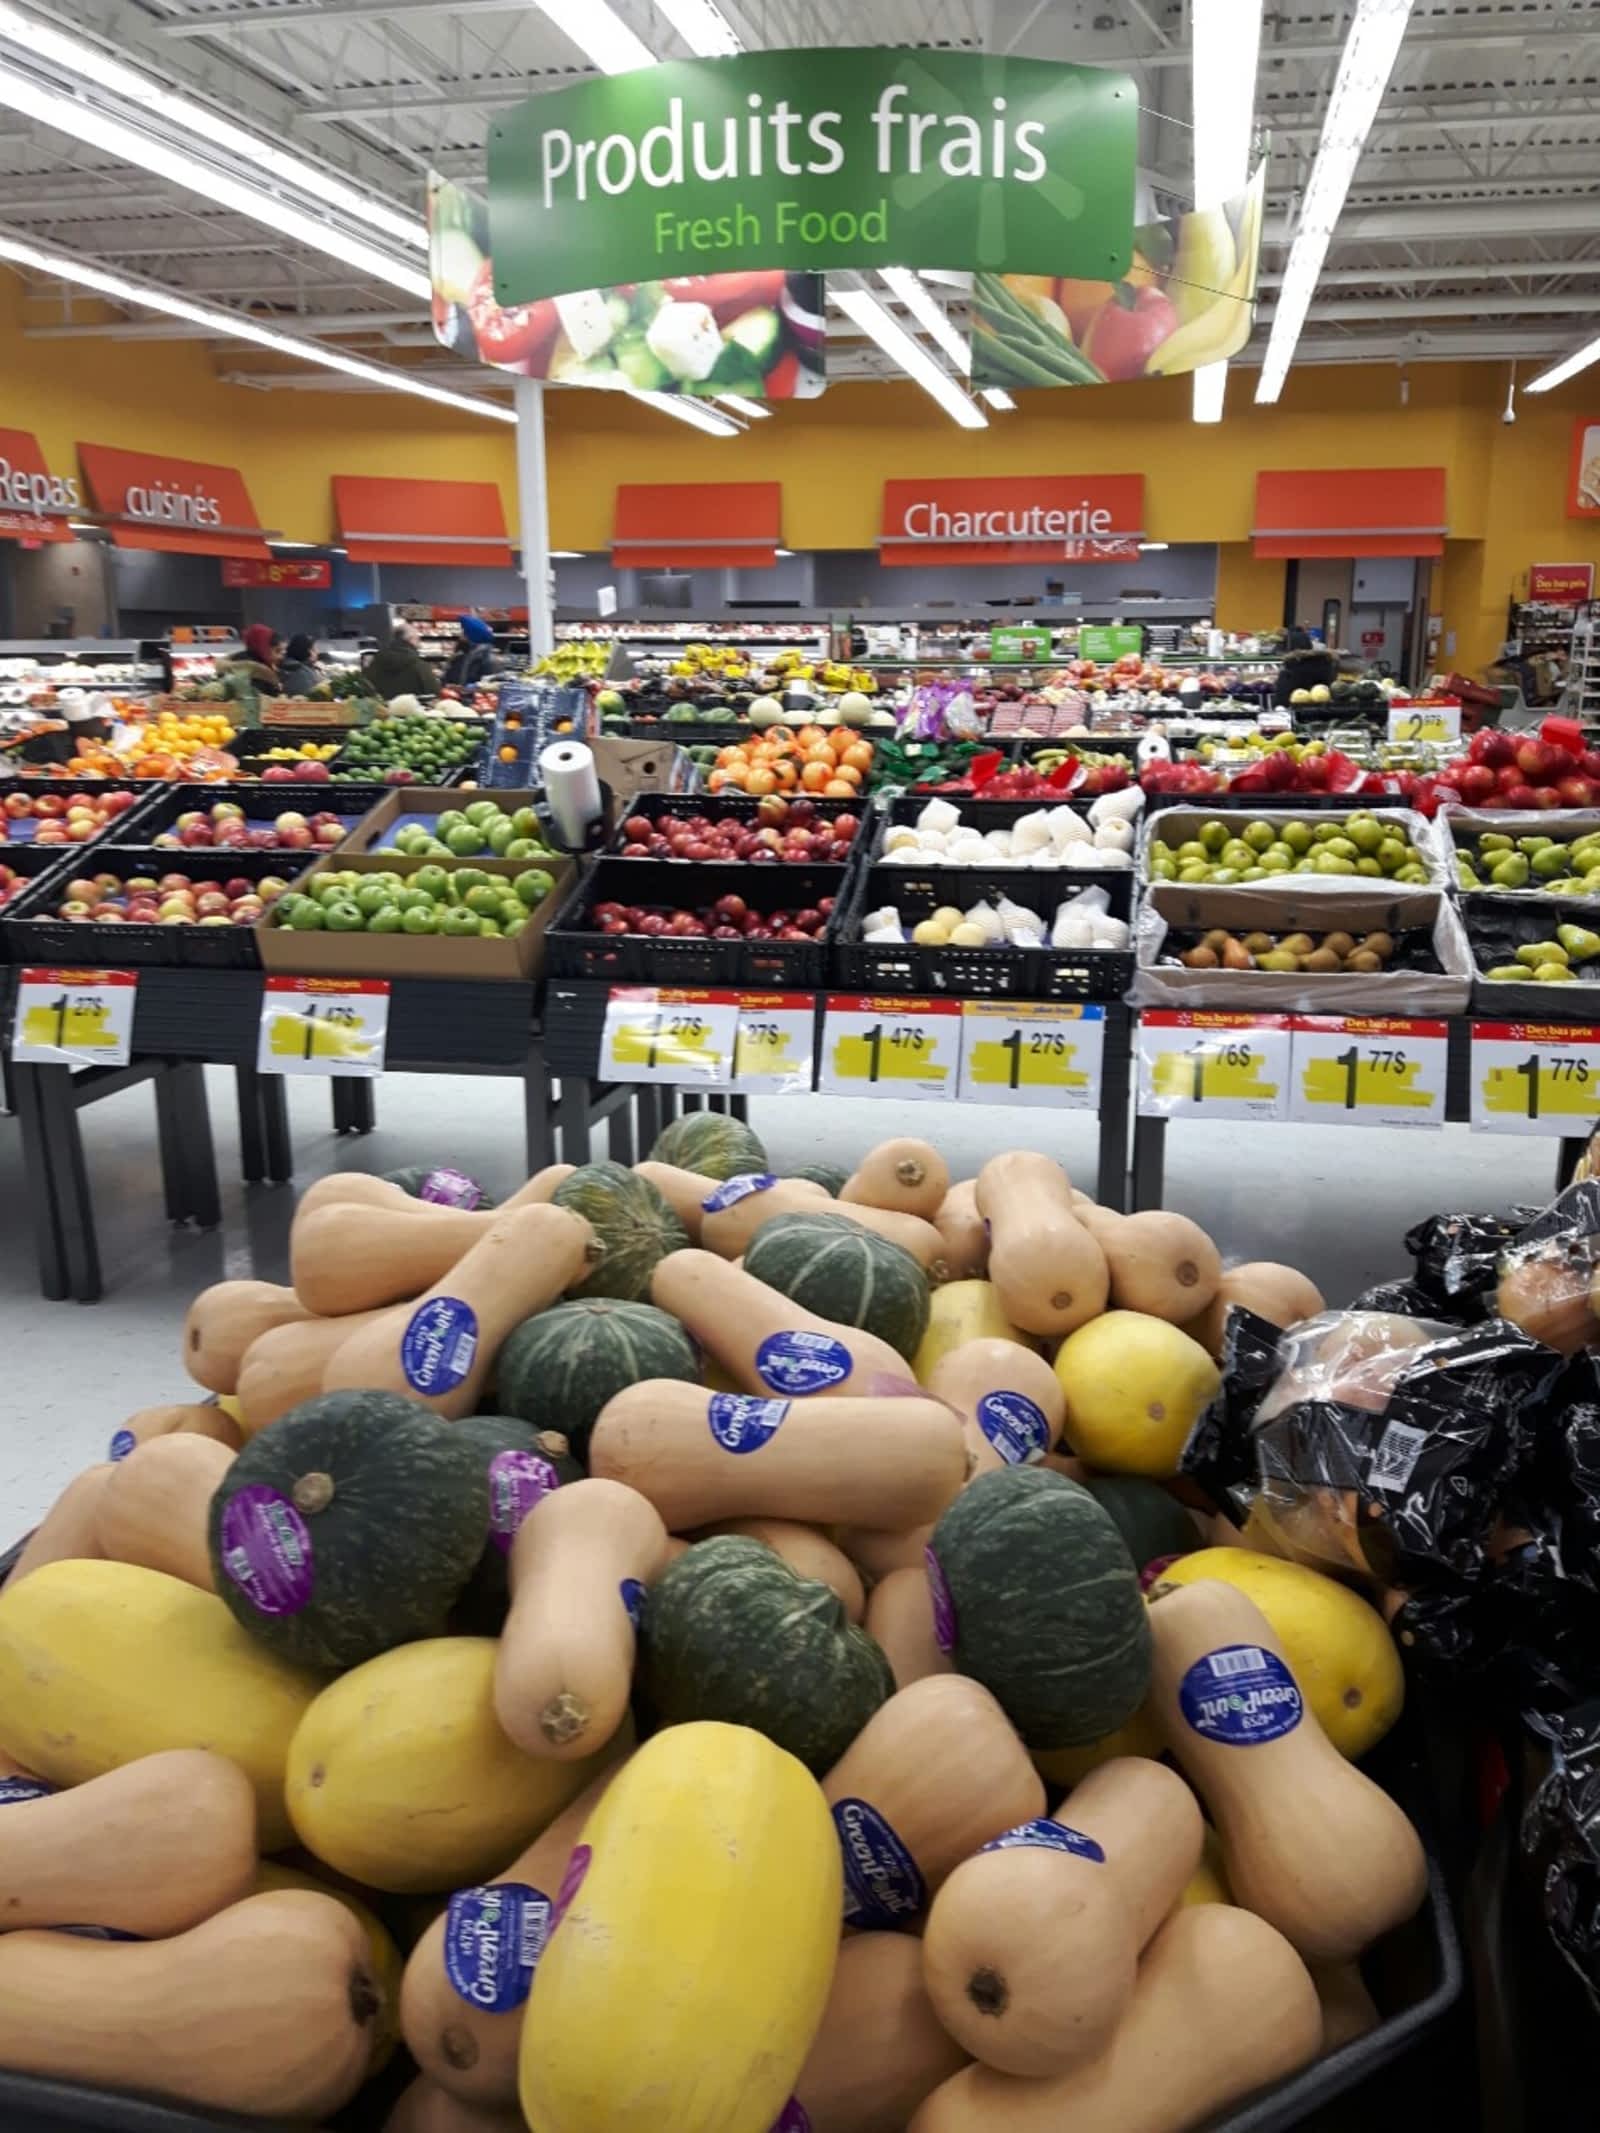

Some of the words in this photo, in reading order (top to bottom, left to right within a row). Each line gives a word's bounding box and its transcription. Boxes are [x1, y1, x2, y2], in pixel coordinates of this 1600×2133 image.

[542, 92, 846, 209] Produits
[871, 85, 1048, 184] frais
[655, 204, 762, 254] Fresh
[775, 199, 889, 245] Food
[126, 481, 222, 526] cuisinés
[904, 501, 1112, 538] Charcuterie
[1409, 713, 1423, 742] 2
[50, 993, 69, 1049] 1
[1390, 1020, 1412, 1031] prix
[1526, 1024, 1548, 1035] Des
[1549, 1025, 1569, 1036] bas
[1570, 1027, 1593, 1038] prix
[863, 1024, 883, 1083] 1
[1002, 1029, 1022, 1089] 1
[1336, 1045, 1358, 1110] 1
[1516, 1053, 1539, 1120] 1
